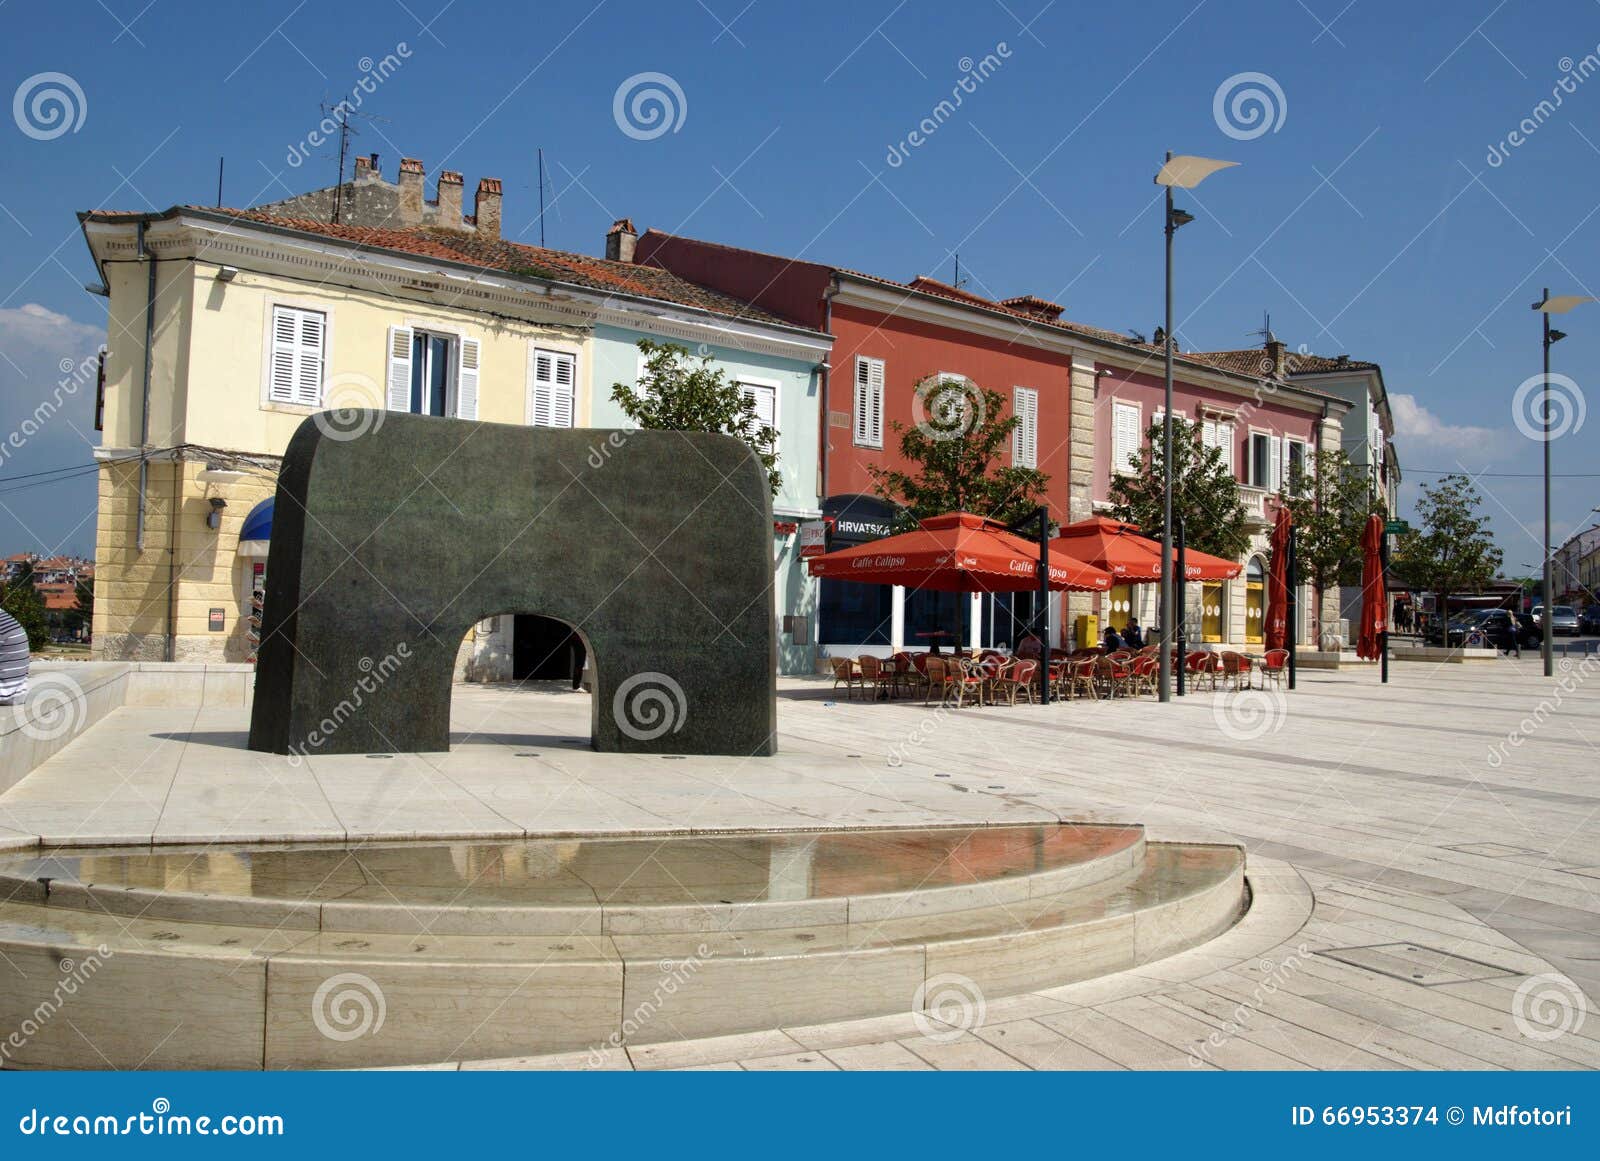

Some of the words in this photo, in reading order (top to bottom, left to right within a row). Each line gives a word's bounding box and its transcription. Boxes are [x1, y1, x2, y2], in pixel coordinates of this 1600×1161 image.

[838, 520, 891, 536] HRVATSKA
[875, 555, 905, 569] Calipso
[1009, 559, 1033, 573] Caffe
